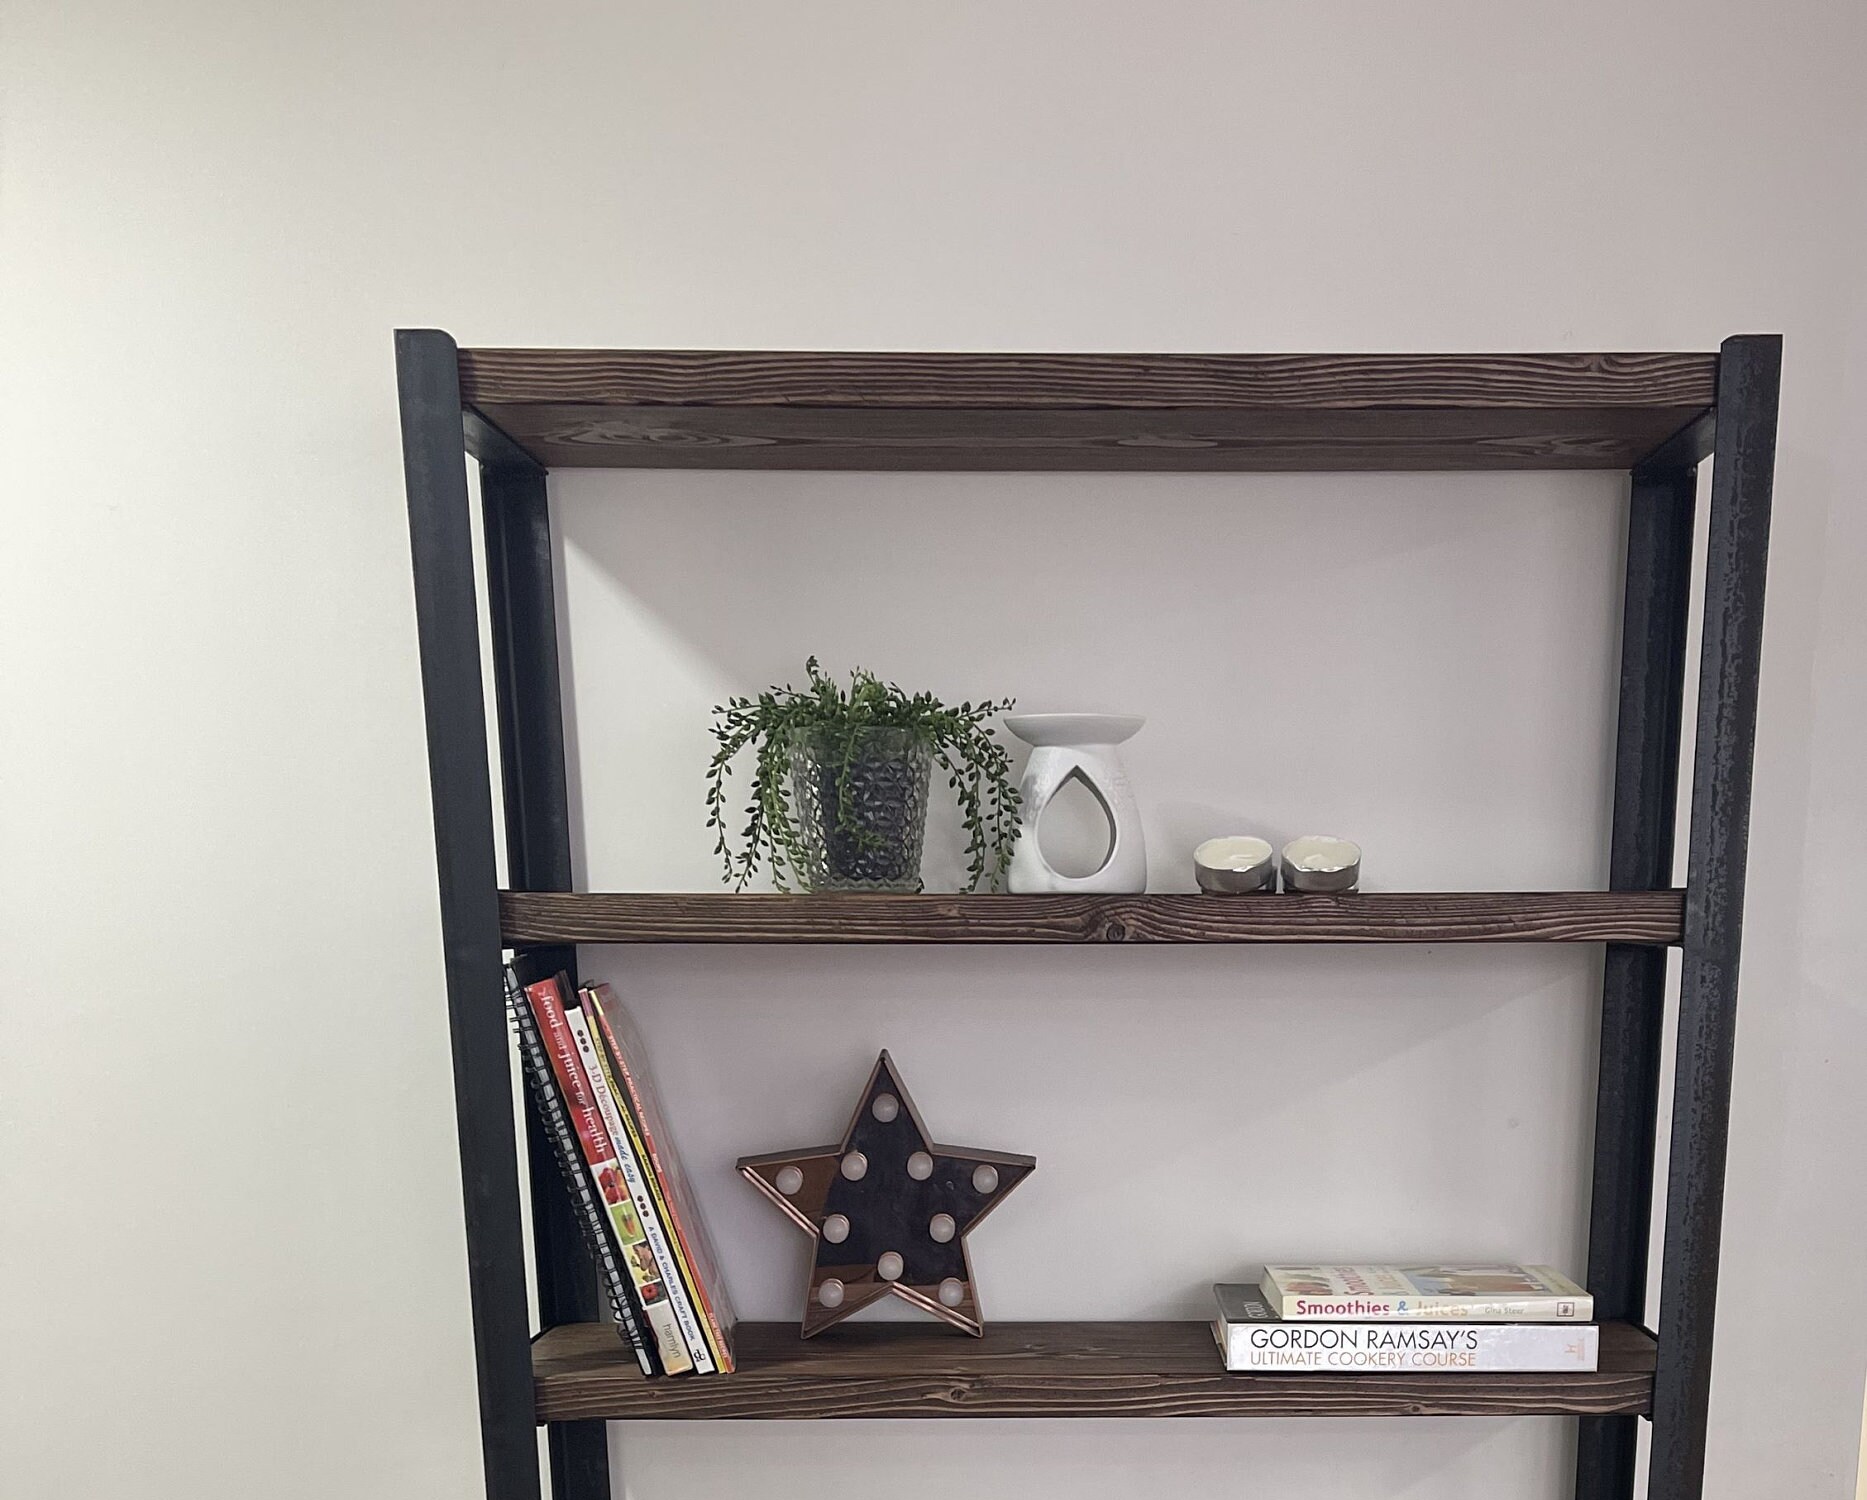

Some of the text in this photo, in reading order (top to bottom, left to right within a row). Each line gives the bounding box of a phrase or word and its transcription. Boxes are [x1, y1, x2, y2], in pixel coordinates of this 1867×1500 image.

[541, 995, 609, 1153] food and juice for health
[589, 1064, 602, 1084] 3-D
[614, 1135, 628, 1160] made
[623, 1162, 635, 1184] easy
[650, 1231, 663, 1254] DAVID
[661, 1260, 679, 1295] CHARLES
[674, 1294, 688, 1319] CRAFT
[683, 1318, 696, 1341] BOOK
[1296, 1299, 1468, 1316] Smoothies & Juices
[1484, 1306, 1524, 1315] Gina Steer
[662, 1322, 681, 1359] hamlyn
[1250, 1329, 1478, 1350] GORDON RAMSAY'S
[1250, 1351, 1476, 1367] ULTIMATE COOKERY COURSE
